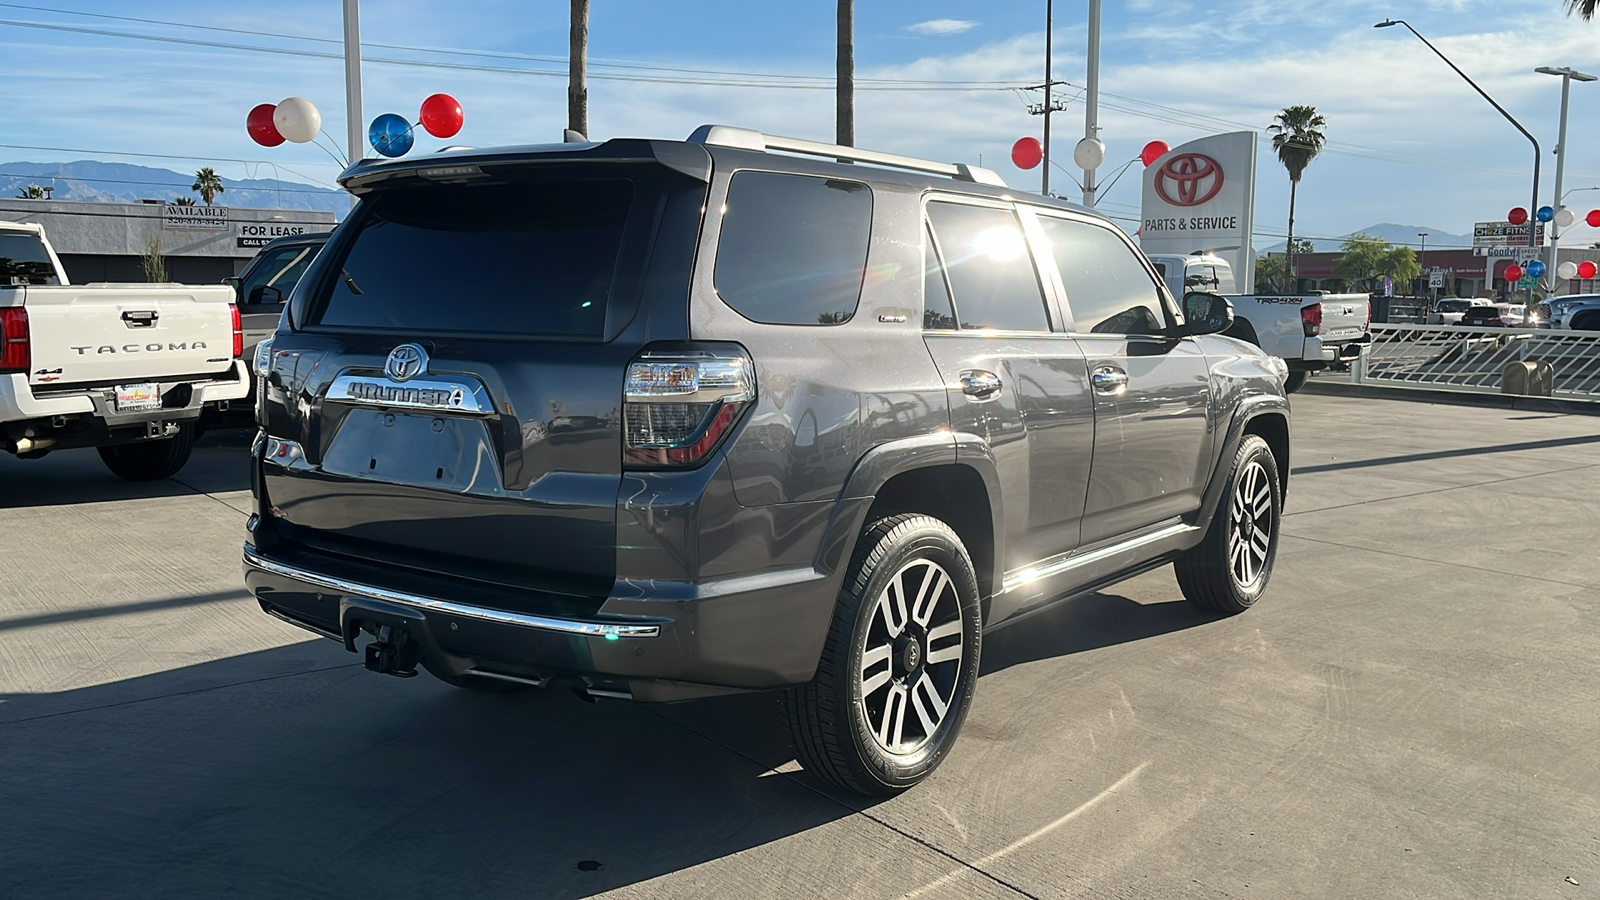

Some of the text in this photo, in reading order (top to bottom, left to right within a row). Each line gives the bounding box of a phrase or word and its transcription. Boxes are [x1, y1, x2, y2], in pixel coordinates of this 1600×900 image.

[165, 206, 227, 217] AVAILABLE
[1145, 216, 1237, 231] PARTS & SERVICE
[242, 225, 304, 237] FOR LEASE
[70, 341, 208, 355] TACOMA
[346, 381, 452, 406] 4RUNNER
